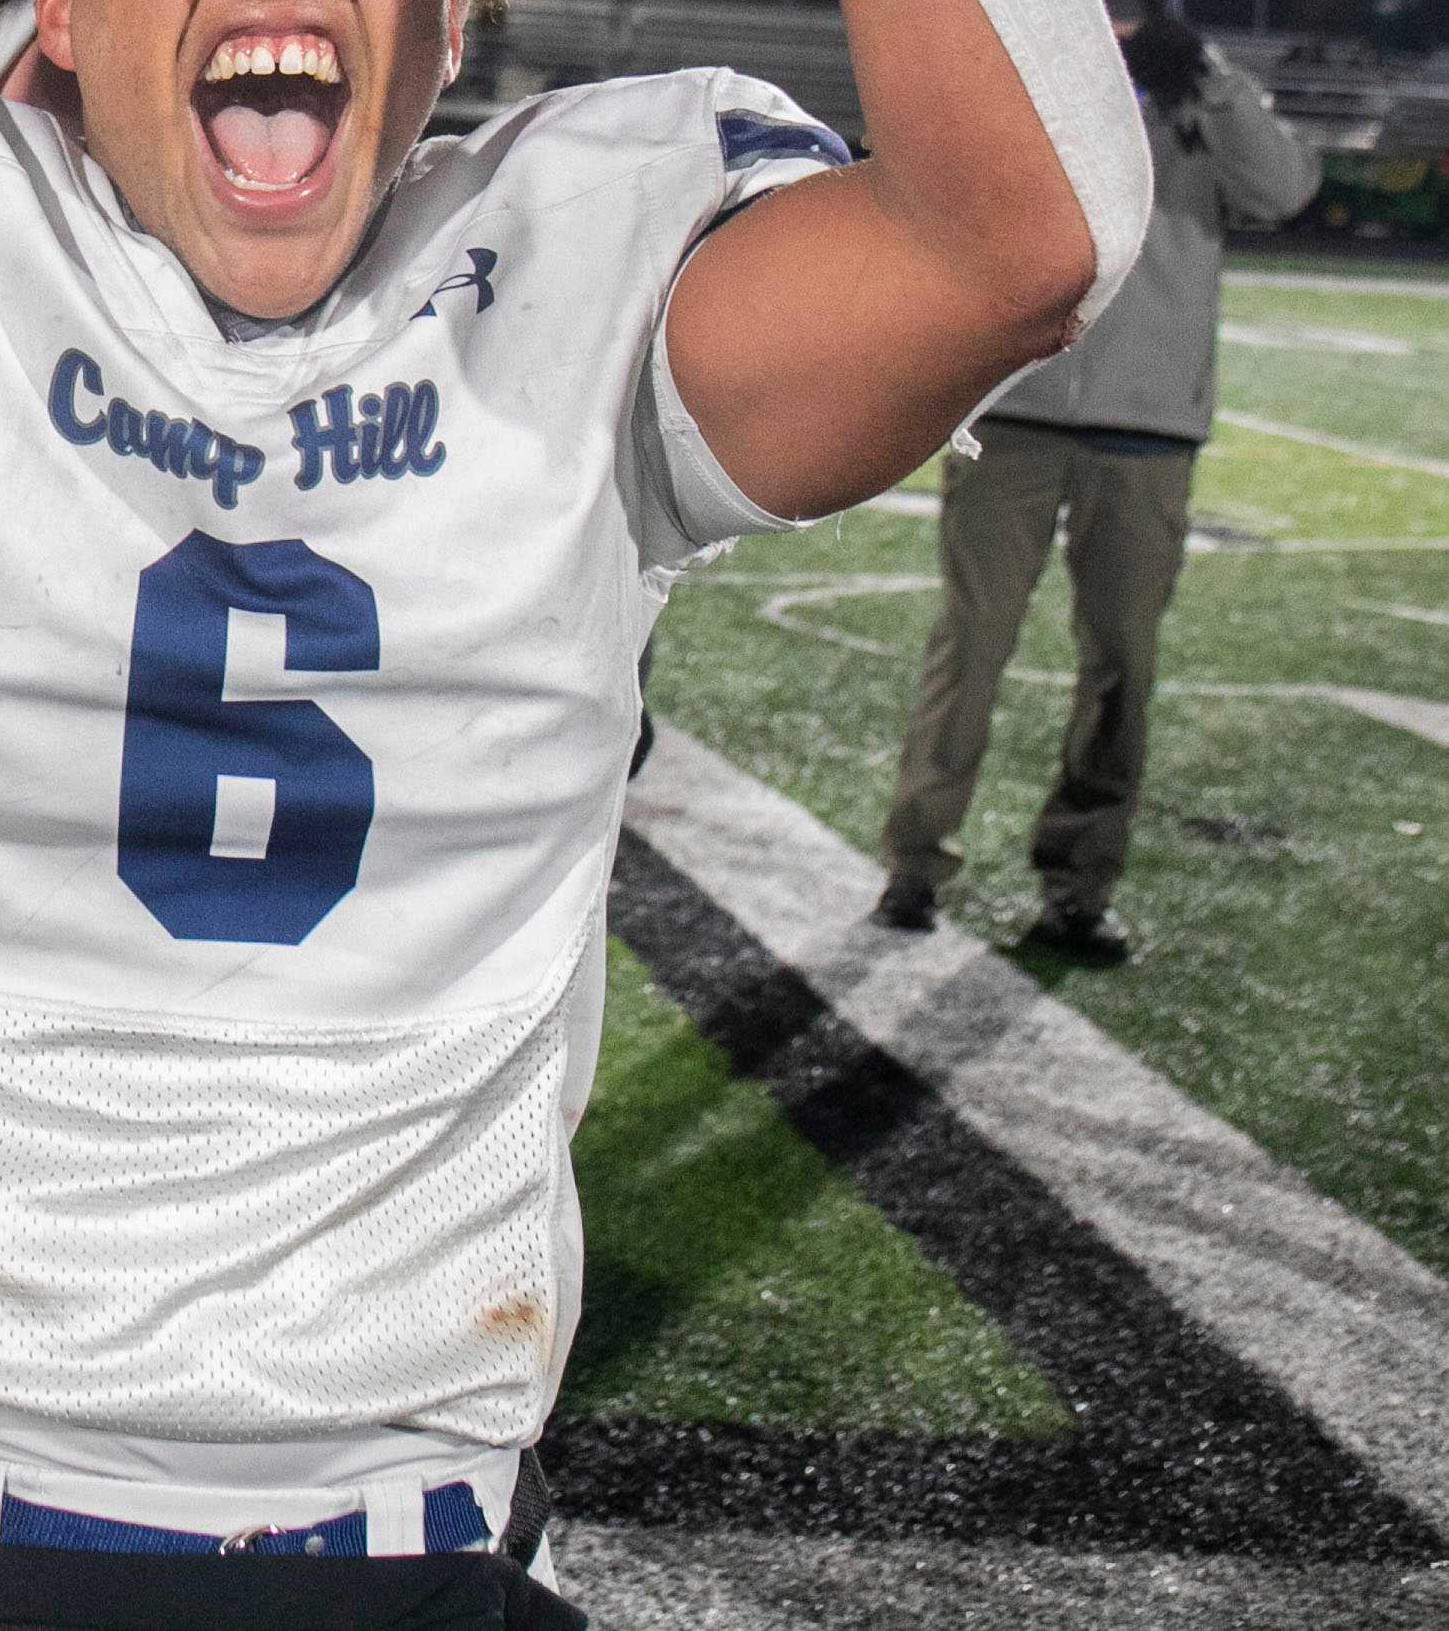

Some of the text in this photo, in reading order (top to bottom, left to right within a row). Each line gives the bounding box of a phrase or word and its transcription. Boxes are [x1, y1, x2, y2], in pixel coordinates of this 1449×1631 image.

[48, 347, 446, 510] Camp Hill
[116, 528, 380, 946] 6
